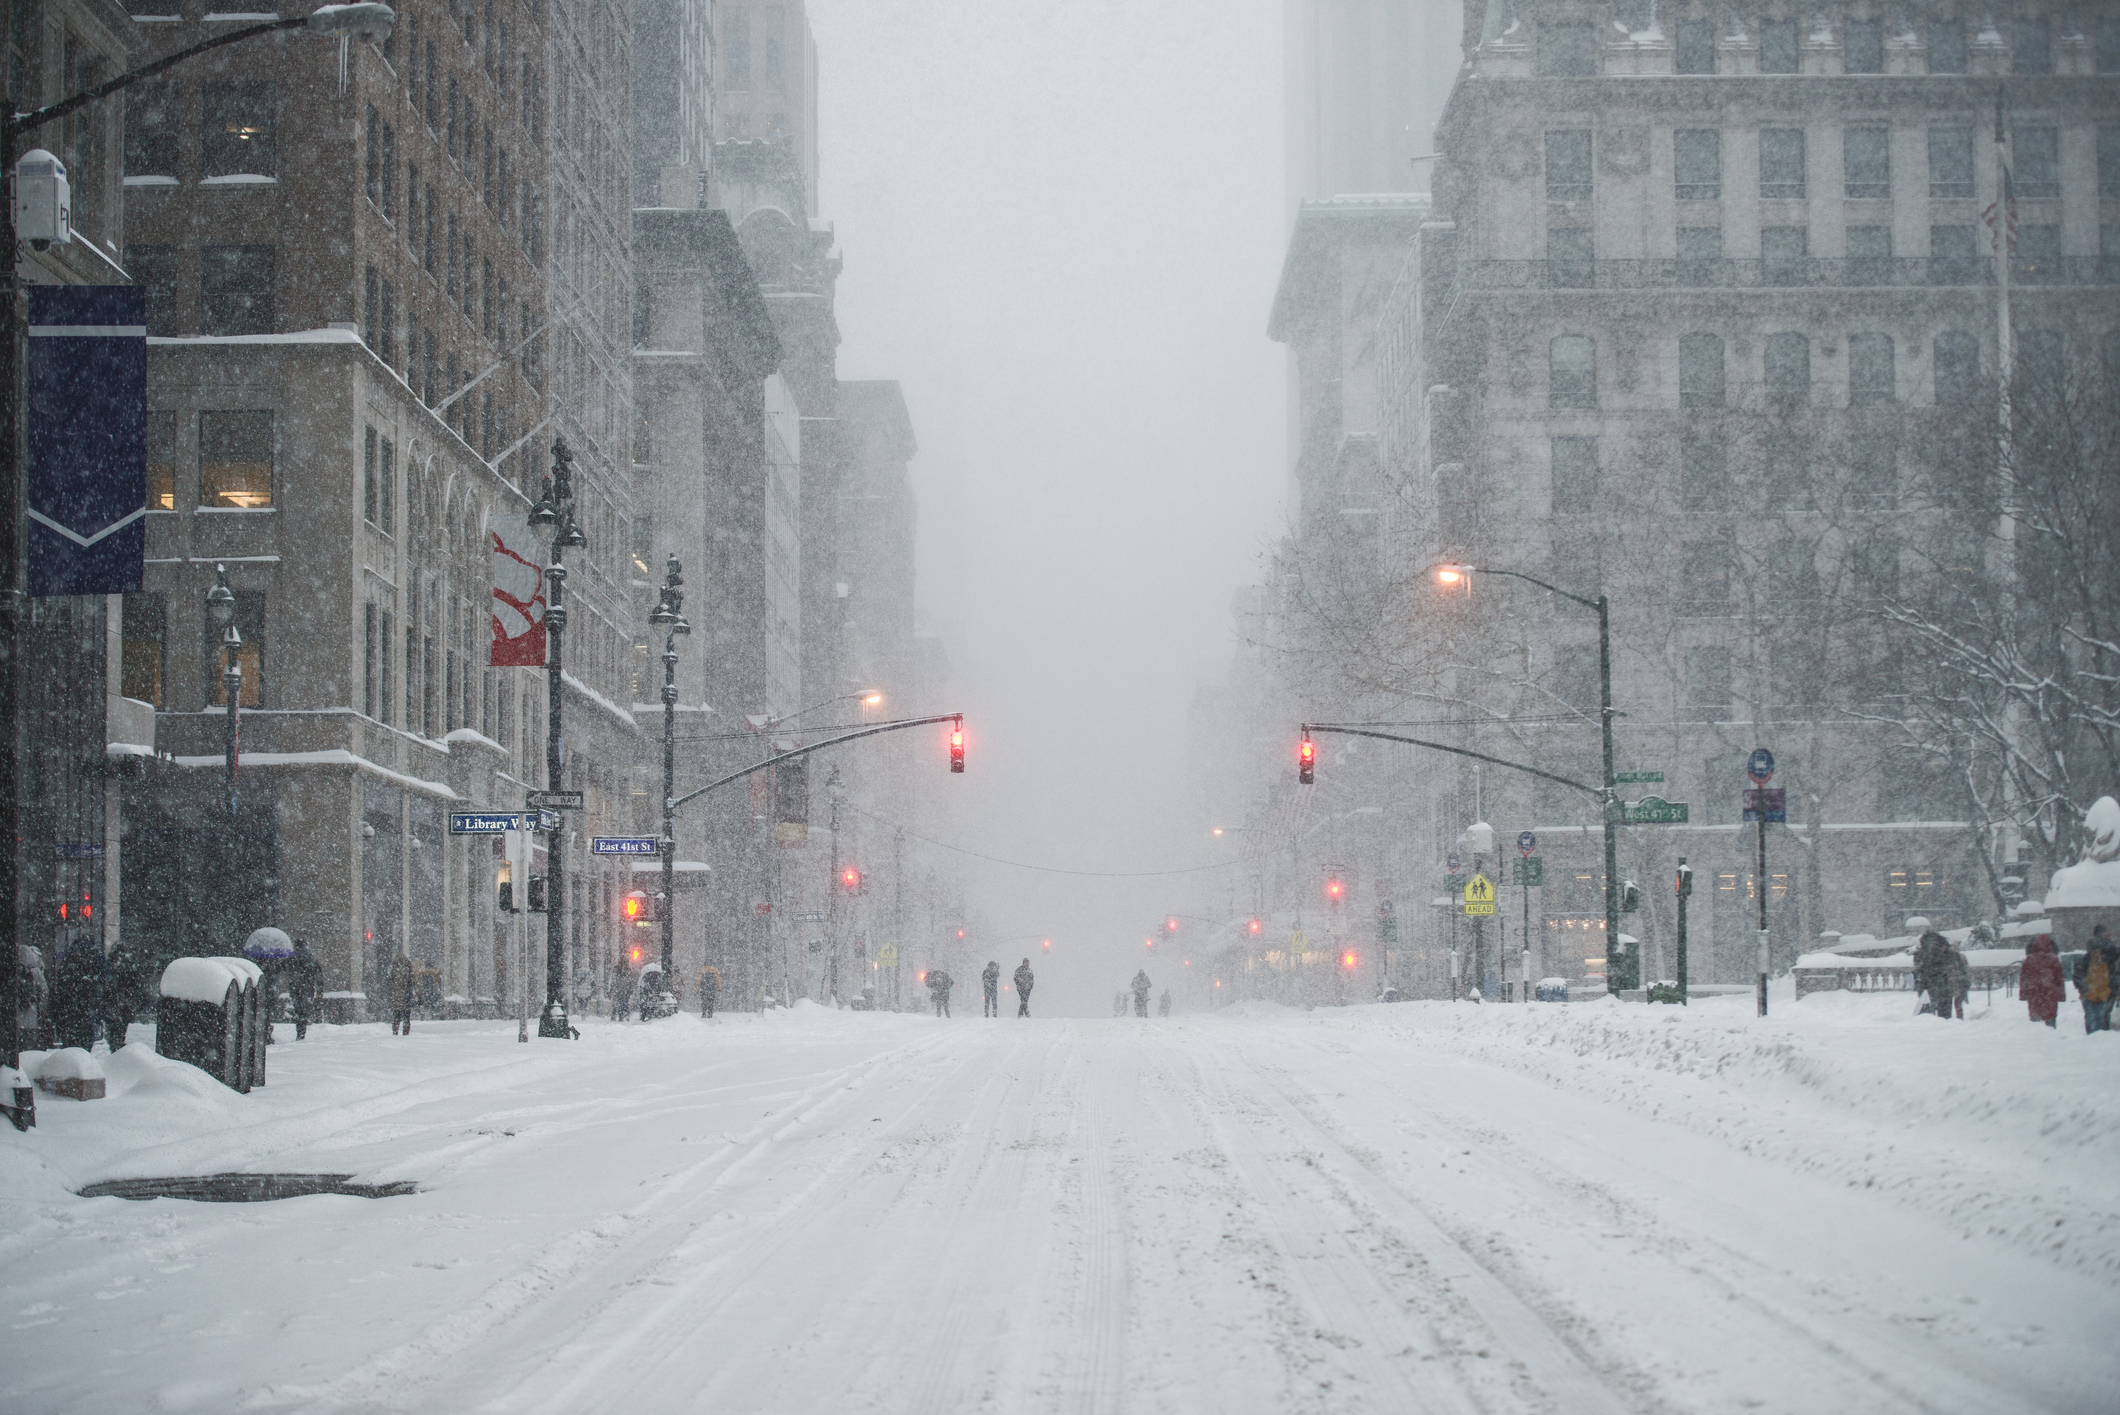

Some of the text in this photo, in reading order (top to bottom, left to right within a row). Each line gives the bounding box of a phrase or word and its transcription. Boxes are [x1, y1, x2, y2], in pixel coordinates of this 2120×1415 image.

[534, 796, 577, 804] ONE WAY
[1625, 808, 1649, 819] West
[1671, 808, 1681, 818] St
[465, 818, 508, 831] Library
[599, 842, 651, 851] East 41st St
[1467, 905, 1492, 913] AHEAD
